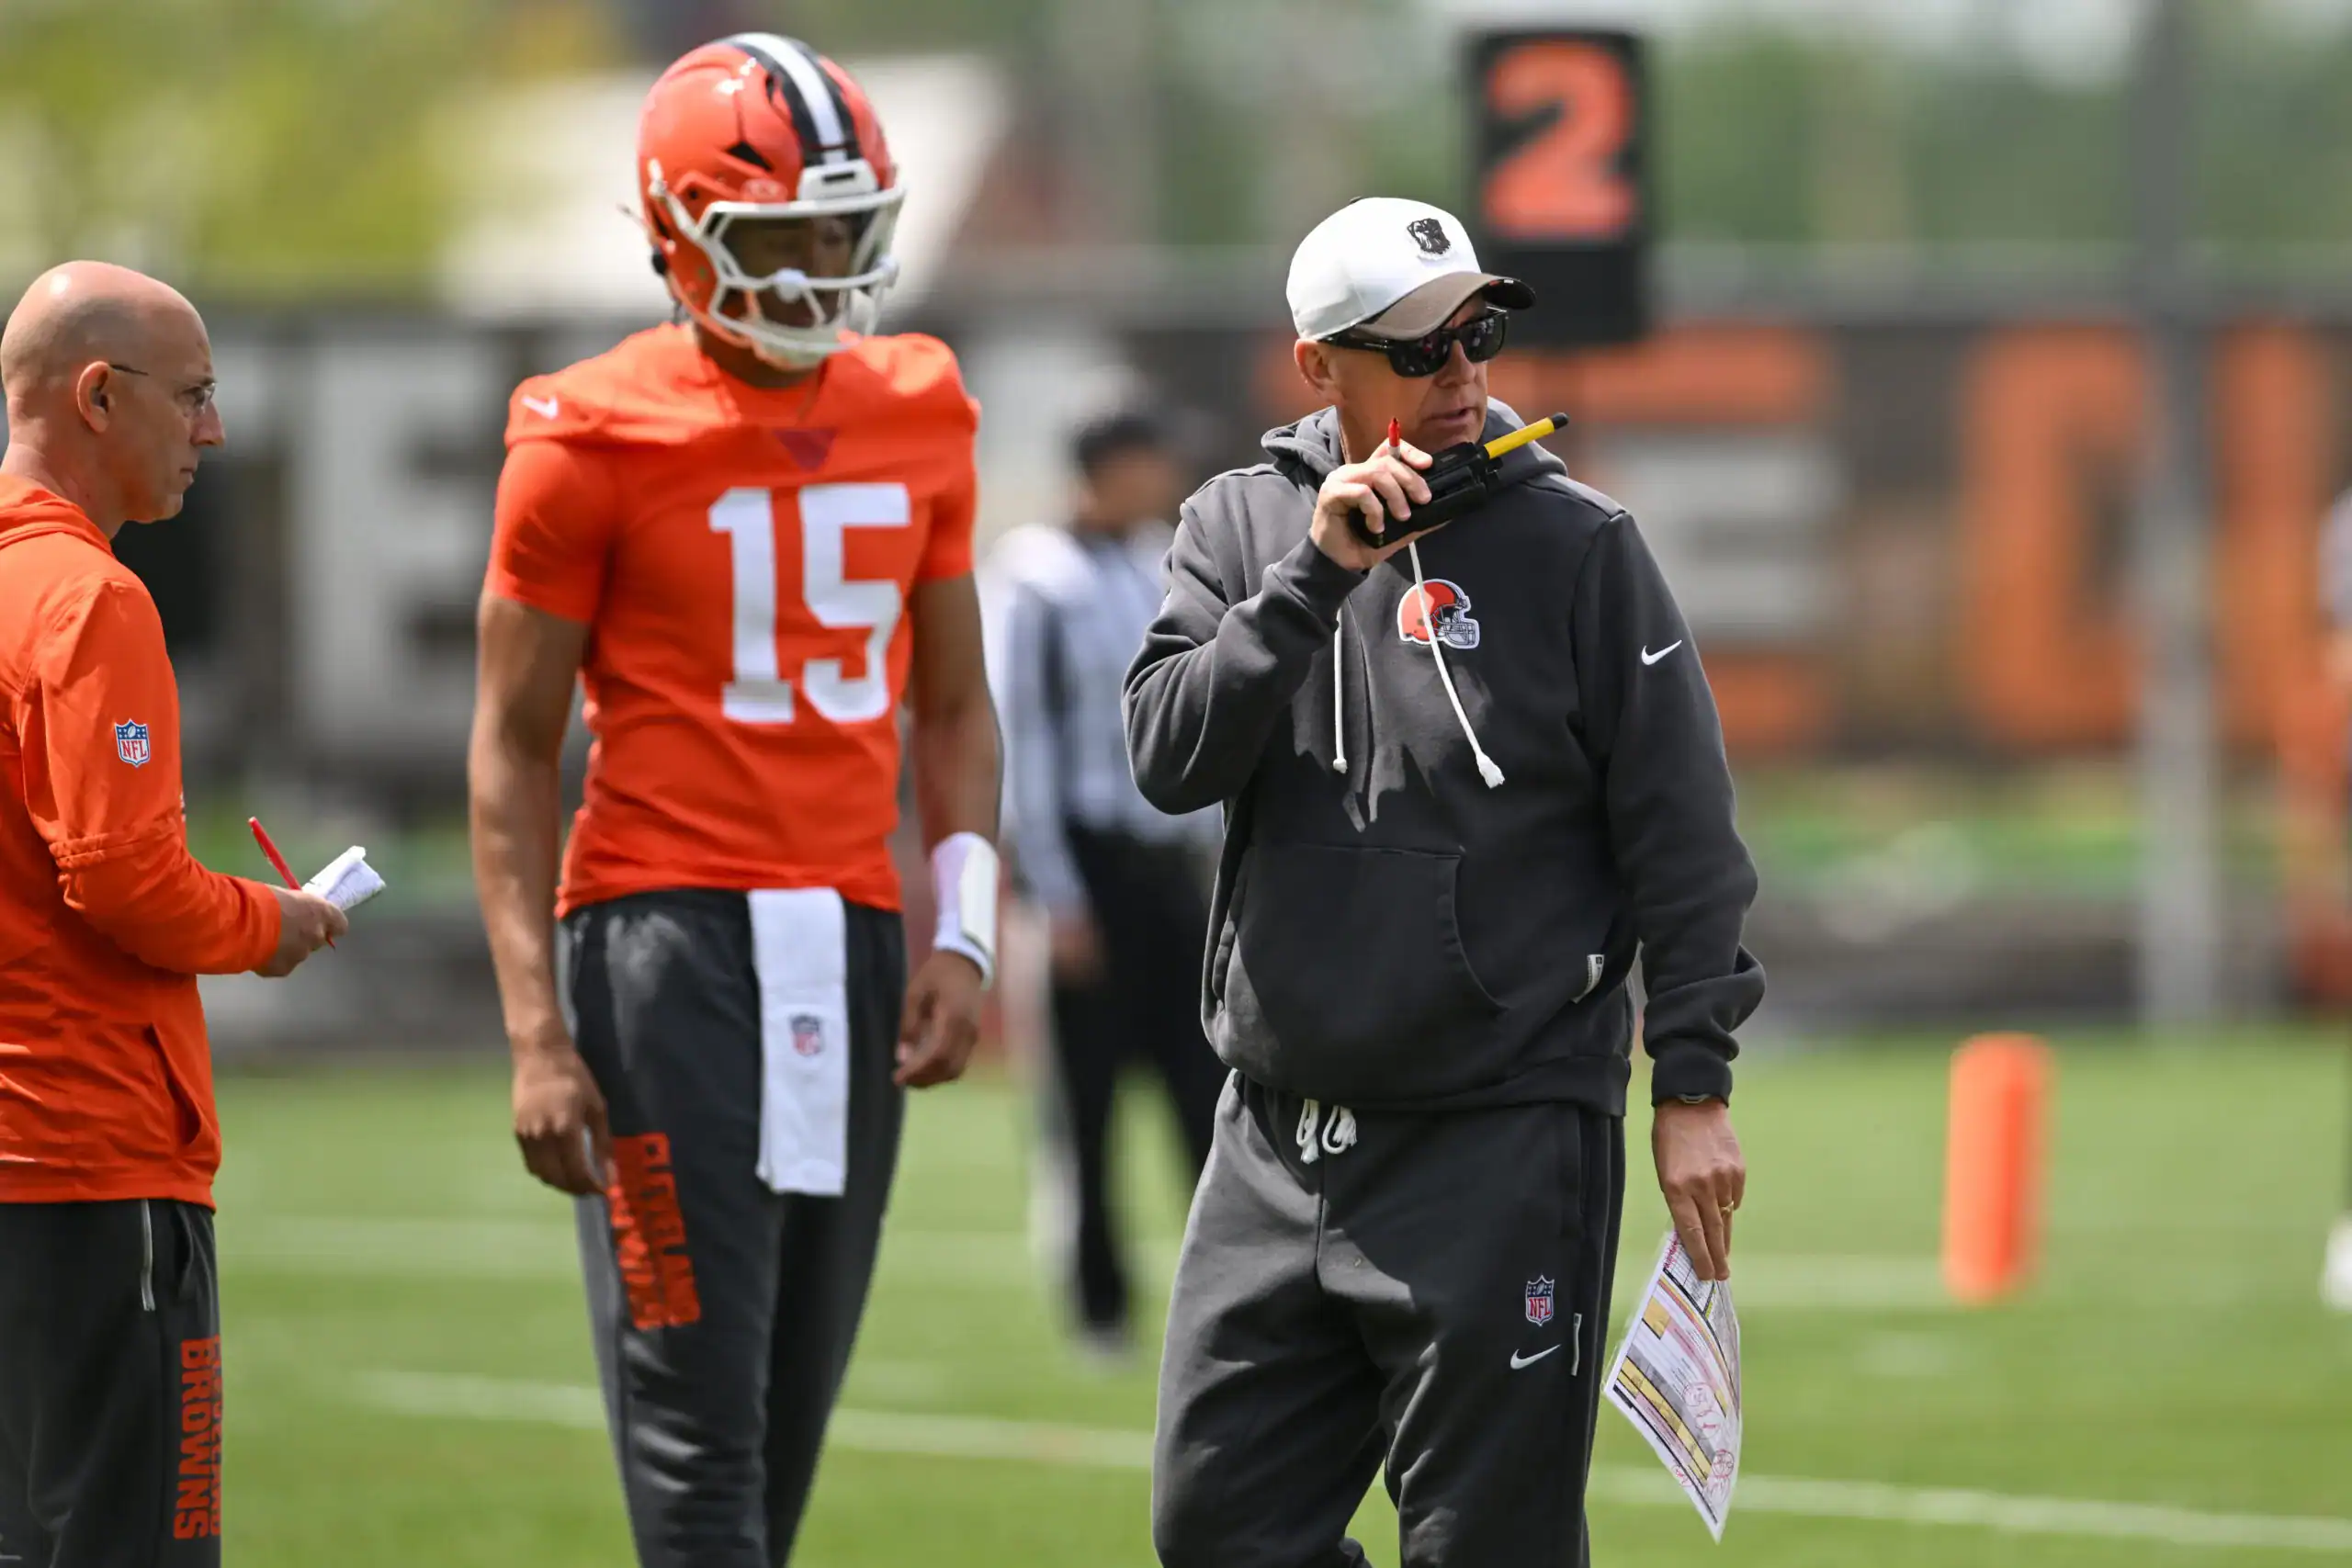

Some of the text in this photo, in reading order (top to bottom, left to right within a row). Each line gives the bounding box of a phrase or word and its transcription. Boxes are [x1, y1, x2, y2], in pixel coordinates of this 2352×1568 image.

[1484, 39, 1633, 237] 2
[707, 482, 911, 723] 15
[120, 739, 147, 761] NFL
[1529, 1296, 1552, 1319] NFL
[173, 1337, 214, 1540] BROWNS
